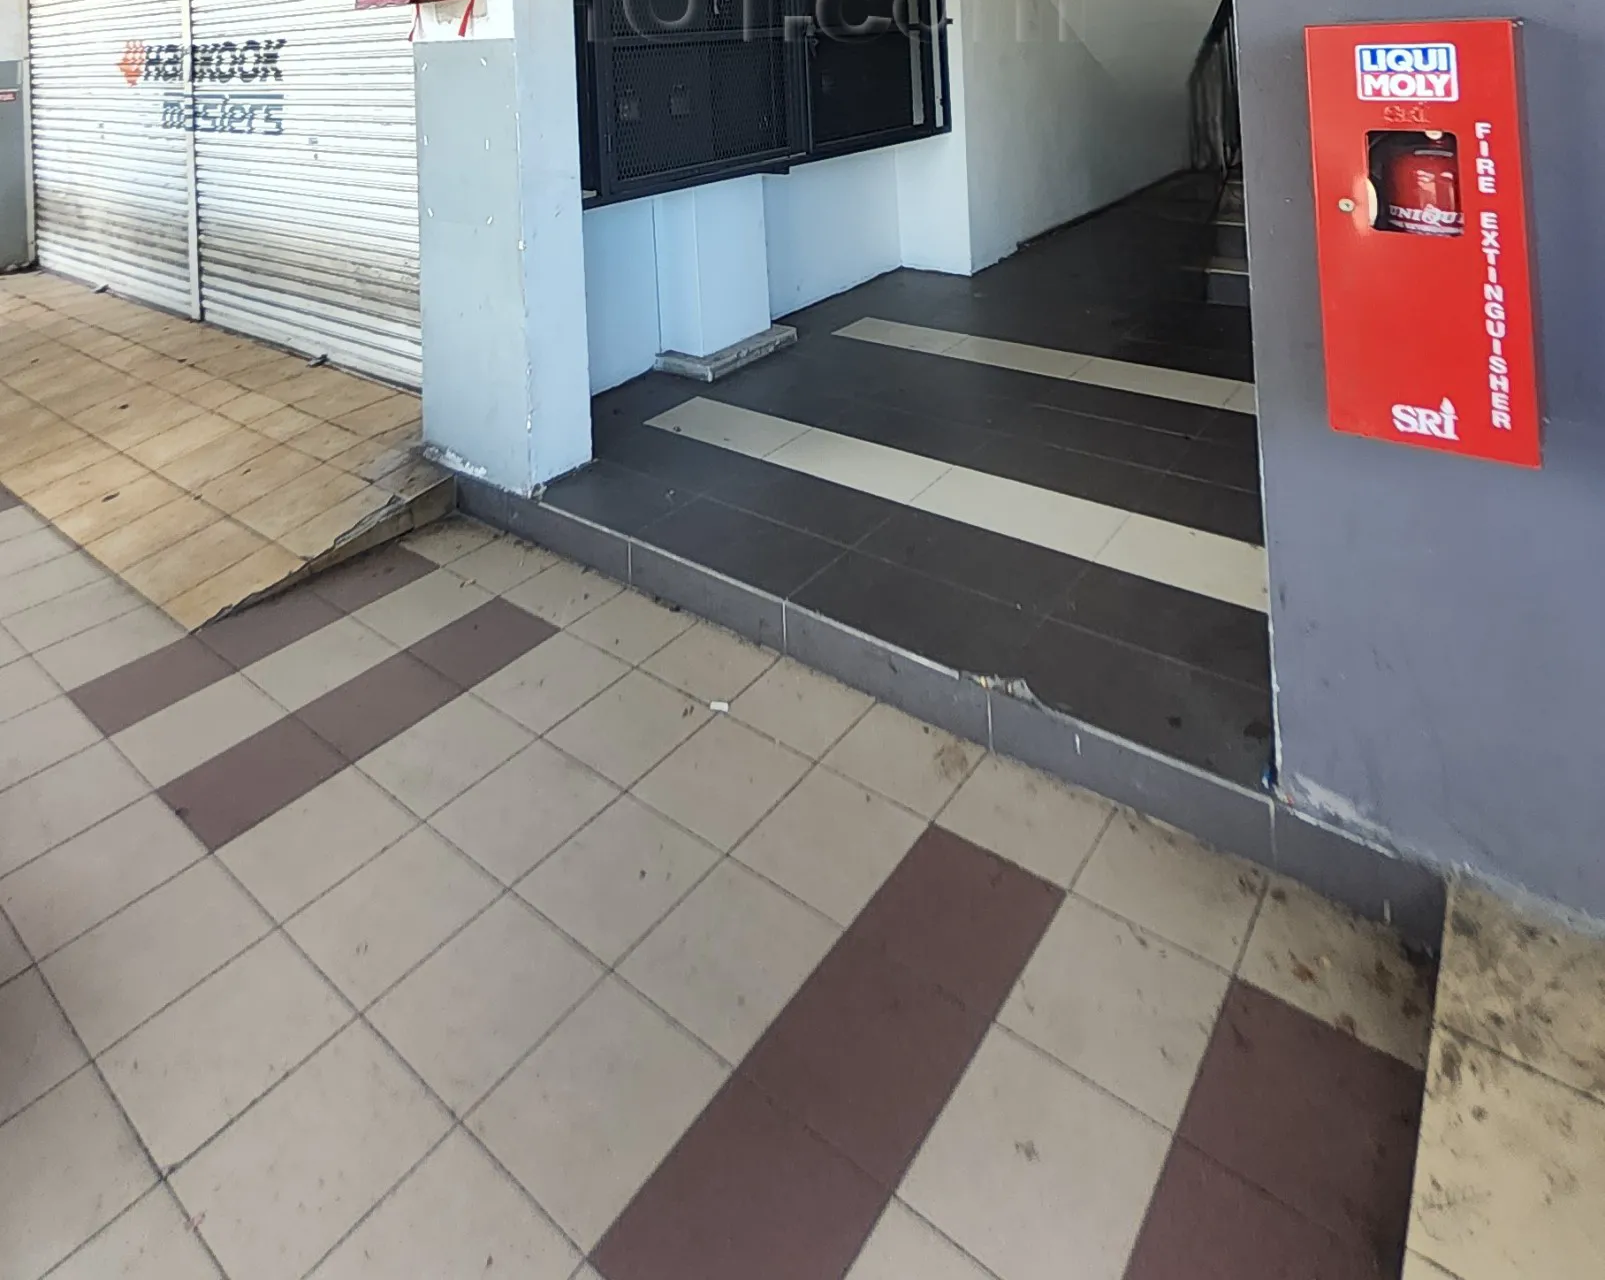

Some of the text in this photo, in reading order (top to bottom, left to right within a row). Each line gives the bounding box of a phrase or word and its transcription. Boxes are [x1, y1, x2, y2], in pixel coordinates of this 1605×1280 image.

[1360, 47, 1448, 72] LIQUI
[1363, 72, 1450, 98] MOLY
[1475, 122, 1497, 194] FIRE
[1480, 211, 1512, 431] EXTINGUISHER
